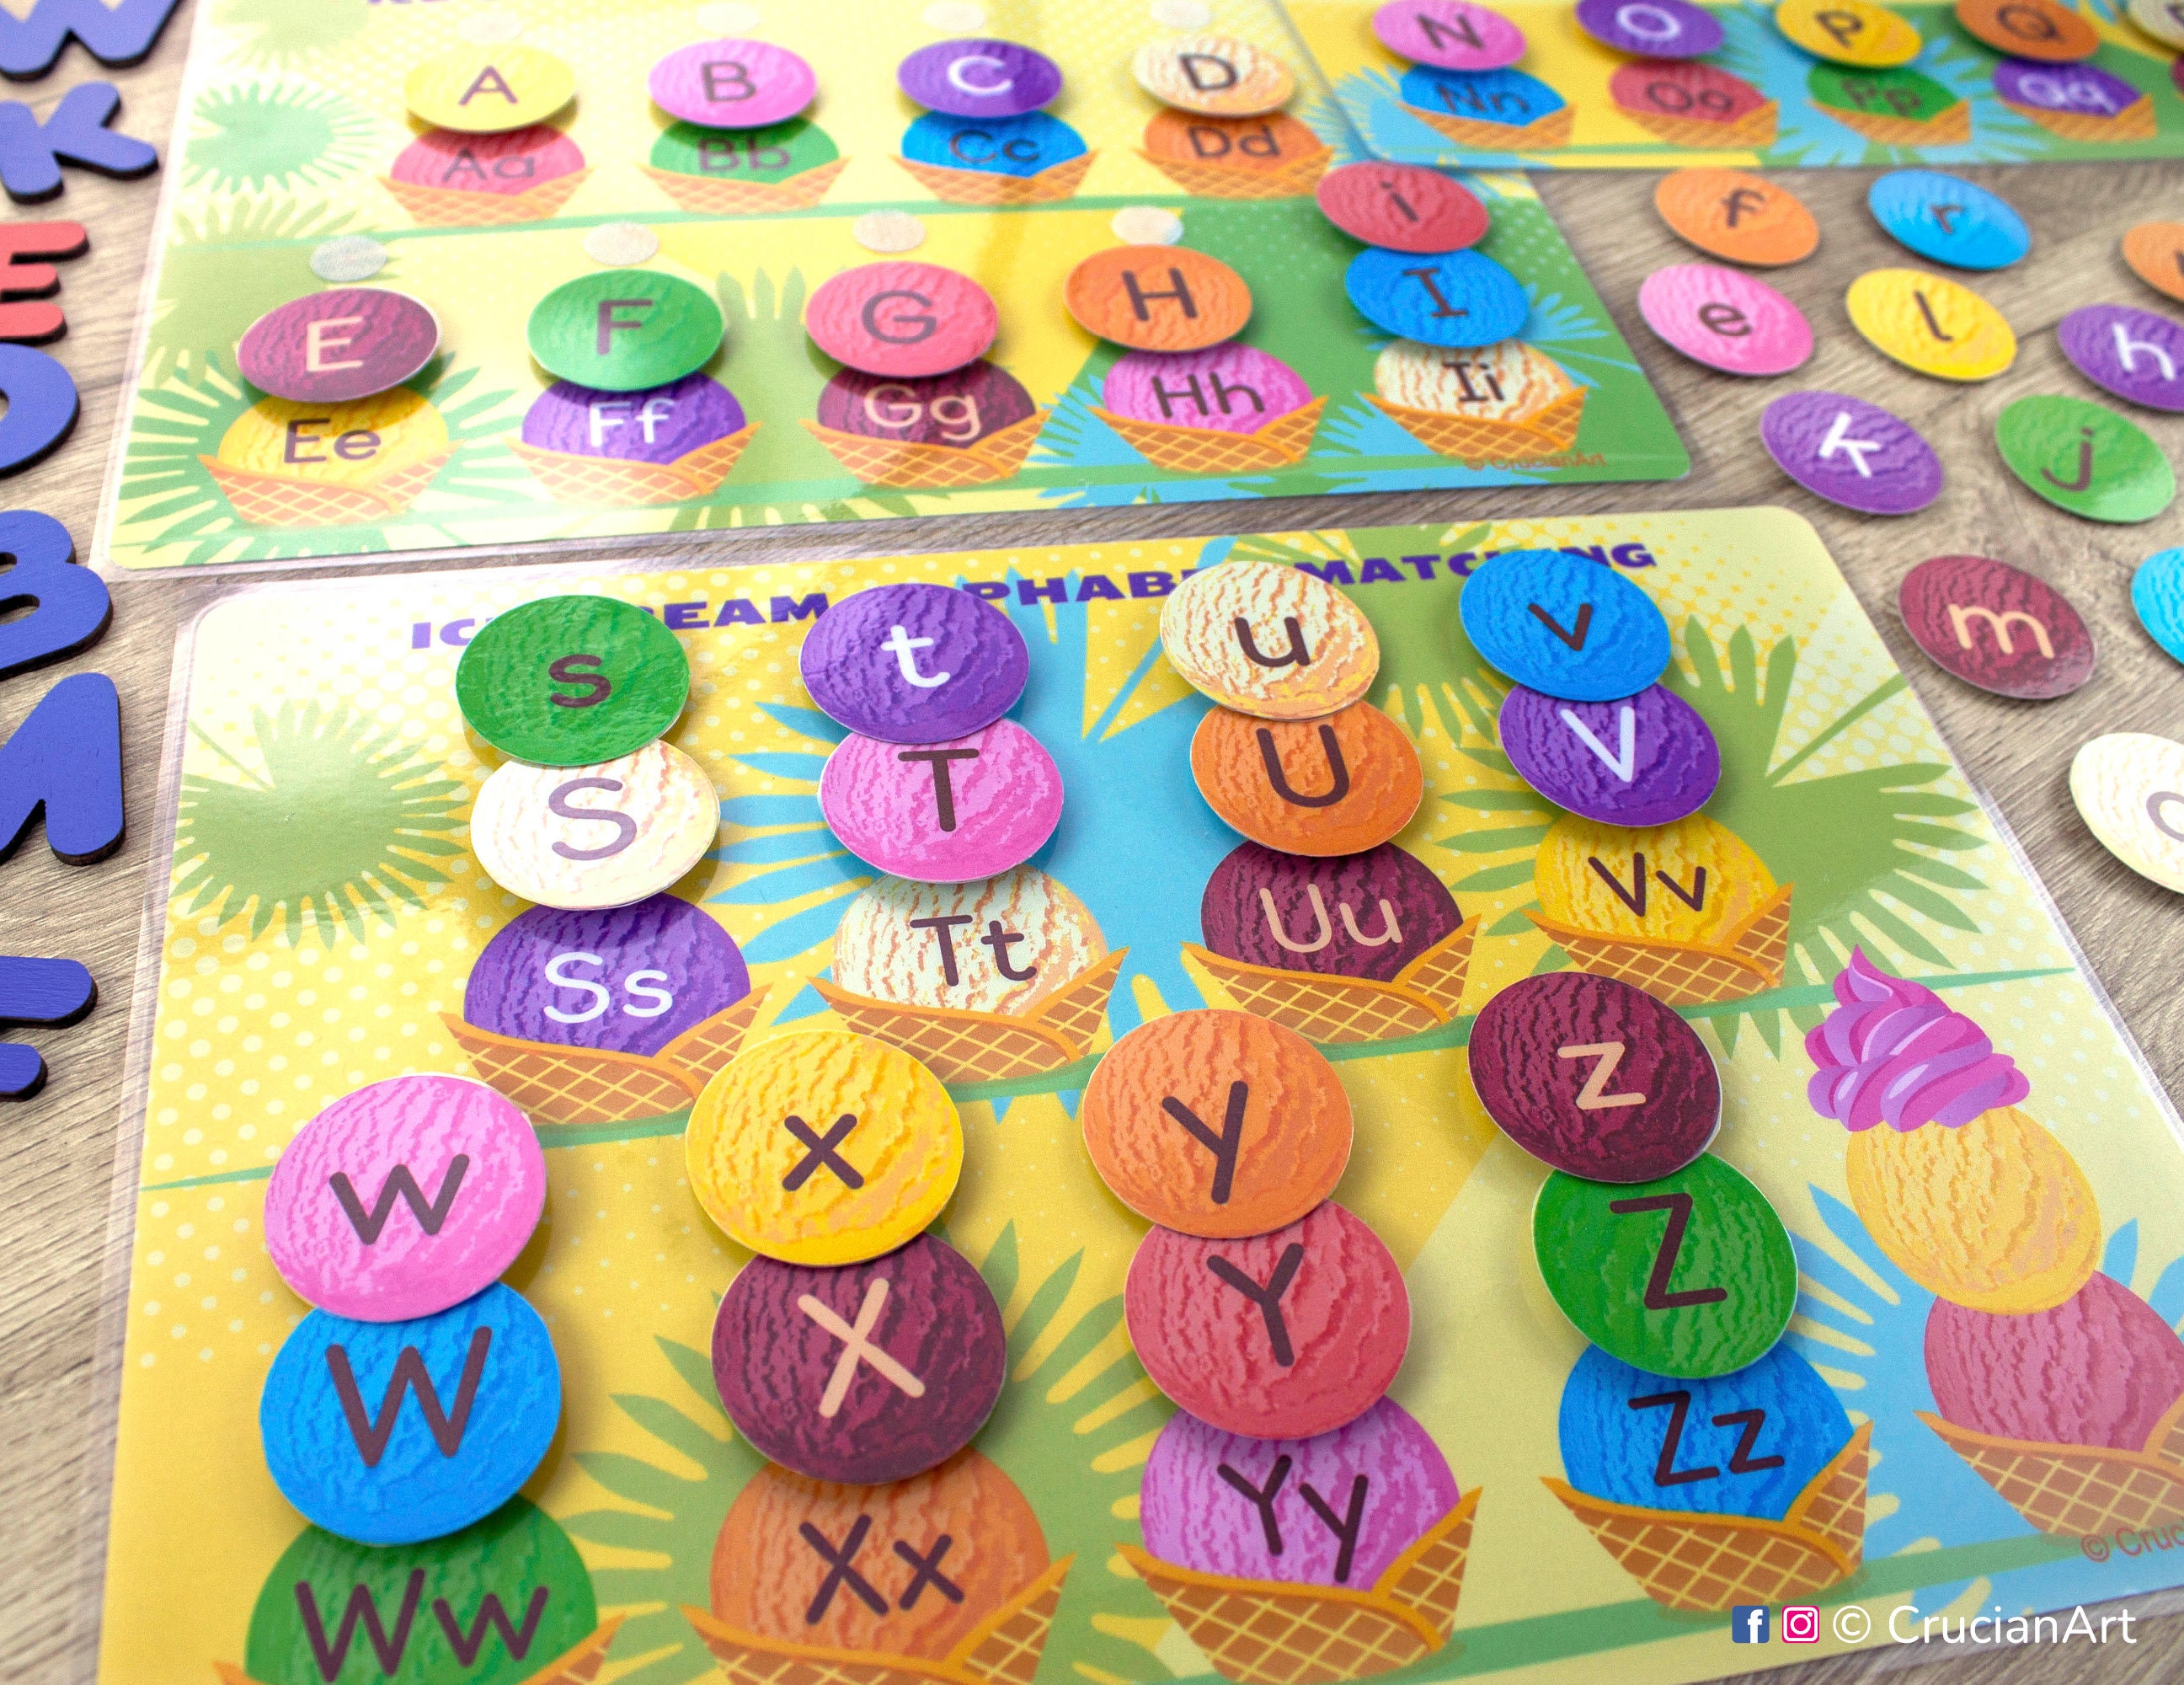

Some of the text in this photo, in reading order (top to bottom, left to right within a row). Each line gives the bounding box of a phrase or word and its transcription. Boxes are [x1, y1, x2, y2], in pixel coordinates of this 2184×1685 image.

[1416, 13, 1486, 51] N
[1616, 3, 1681, 40] O
[1815, 10, 1862, 48] P
[1998, 3, 2067, 45] Q
[458, 66, 519, 105] A
[701, 61, 756, 102] B
[948, 56, 1013, 96] C
[1178, 53, 1237, 91] D
[1437, 83, 1530, 114] Nn
[1647, 83, 1733, 114] Oo
[441, 148, 535, 182] Aa
[697, 138, 791, 172] Bb
[949, 131, 1039, 163] Cc
[1188, 126, 1280, 158] Dd
[1381, 181, 1418, 222] i
[1720, 187, 1766, 228] f
[862, 290, 937, 345] G
[1122, 267, 1199, 322] H
[1403, 267, 1468, 318] I
[1699, 302, 1753, 337] e
[305, 316, 365, 372] E
[596, 299, 654, 356] F
[2113, 323, 2175, 381] h
[1151, 372, 1264, 418] Hh
[1443, 361, 1504, 403] Ii
[590, 399, 675, 447] Ff
[863, 382, 981, 441] Gg
[283, 419, 382, 463] Ee
[2041, 427, 2095, 493] j
[412, 618, 494, 649] IC
[638, 592, 830, 630] EAM
[1295, 543, 1657, 585] MATCNG
[880, 624, 951, 688] t
[1233, 616, 1311, 668] u
[1948, 603, 2055, 660] m
[1256, 724, 1350, 808] U
[1560, 706, 1635, 783] V
[897, 747, 980, 832] T
[547, 777, 638, 861] S
[1588, 853, 1706, 917] Vv
[1258, 883, 1403, 954] Uu
[910, 914, 1038, 987] Tt
[542, 951, 673, 1024] Ss
[1162, 1080, 1248, 1205] y
[1609, 1192, 1728, 1310] Z
[1208, 1243, 1305, 1367] Y
[796, 1277, 926, 1418] X
[325, 1326, 493, 1468] W
[1628, 1390, 1786, 1486] Zz
[1217, 1454, 1369, 1584] Yy
[799, 1515, 964, 1624] Xx
[296, 1569, 550, 1683] Ww
